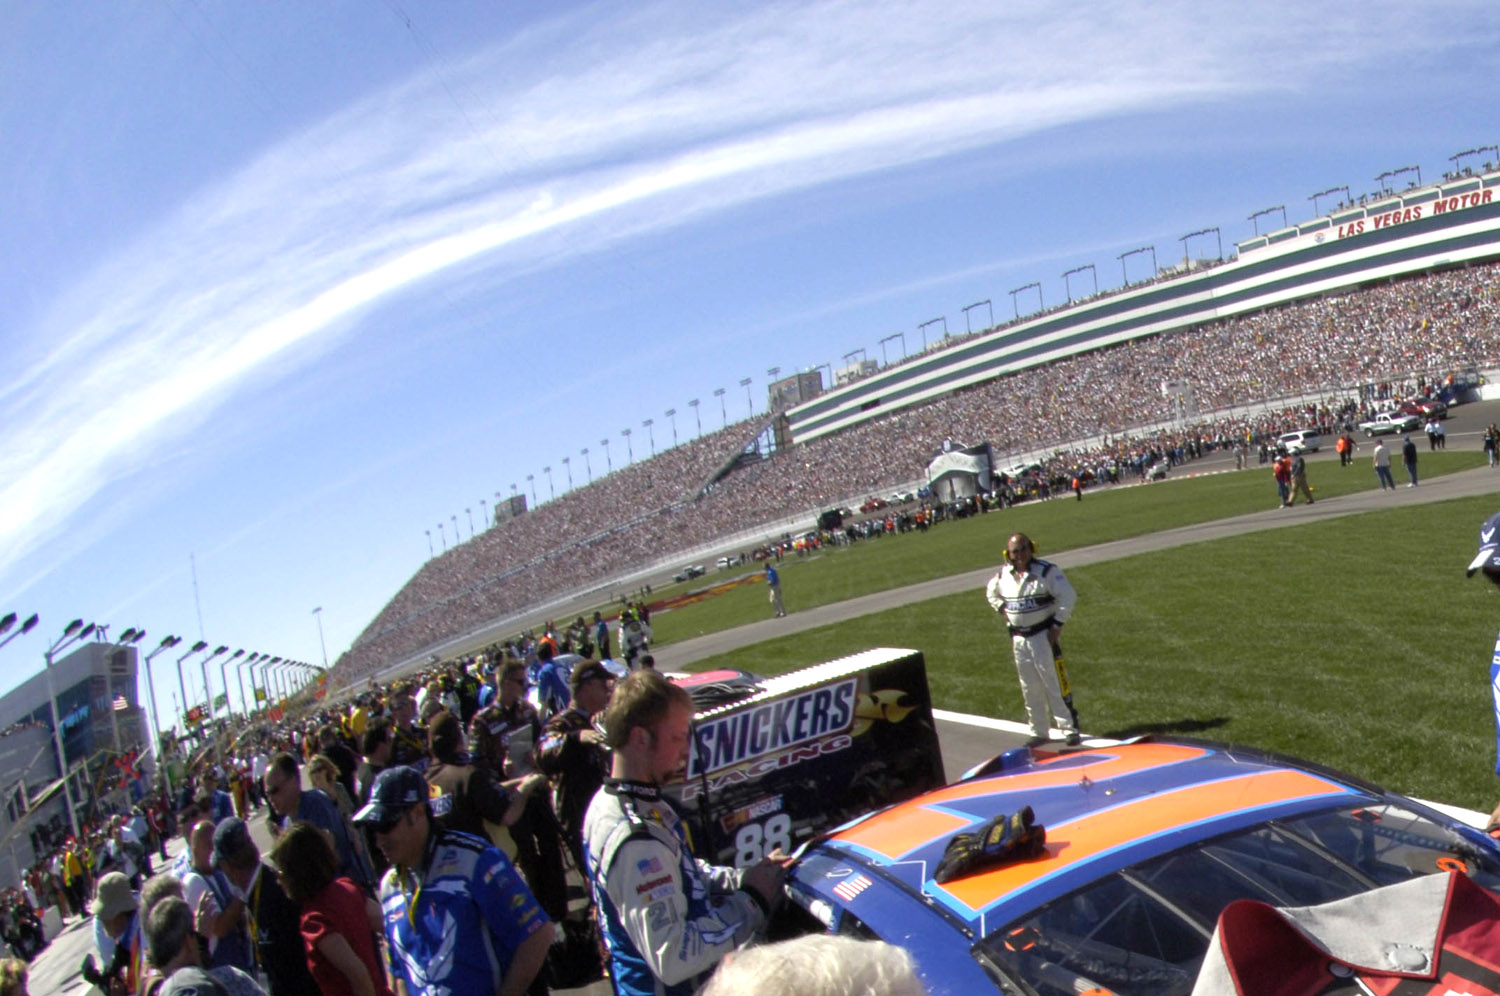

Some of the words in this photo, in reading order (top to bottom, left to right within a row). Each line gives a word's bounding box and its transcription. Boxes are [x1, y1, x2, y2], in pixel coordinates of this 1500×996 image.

[1338, 219, 1365, 239] LAS
[1373, 205, 1423, 231] VEGAS
[1433, 189, 1493, 215] MOTOR
[692, 682, 854, 775] SNICKERS
[682, 735, 852, 800] RACING
[735, 813, 791, 869] 88
